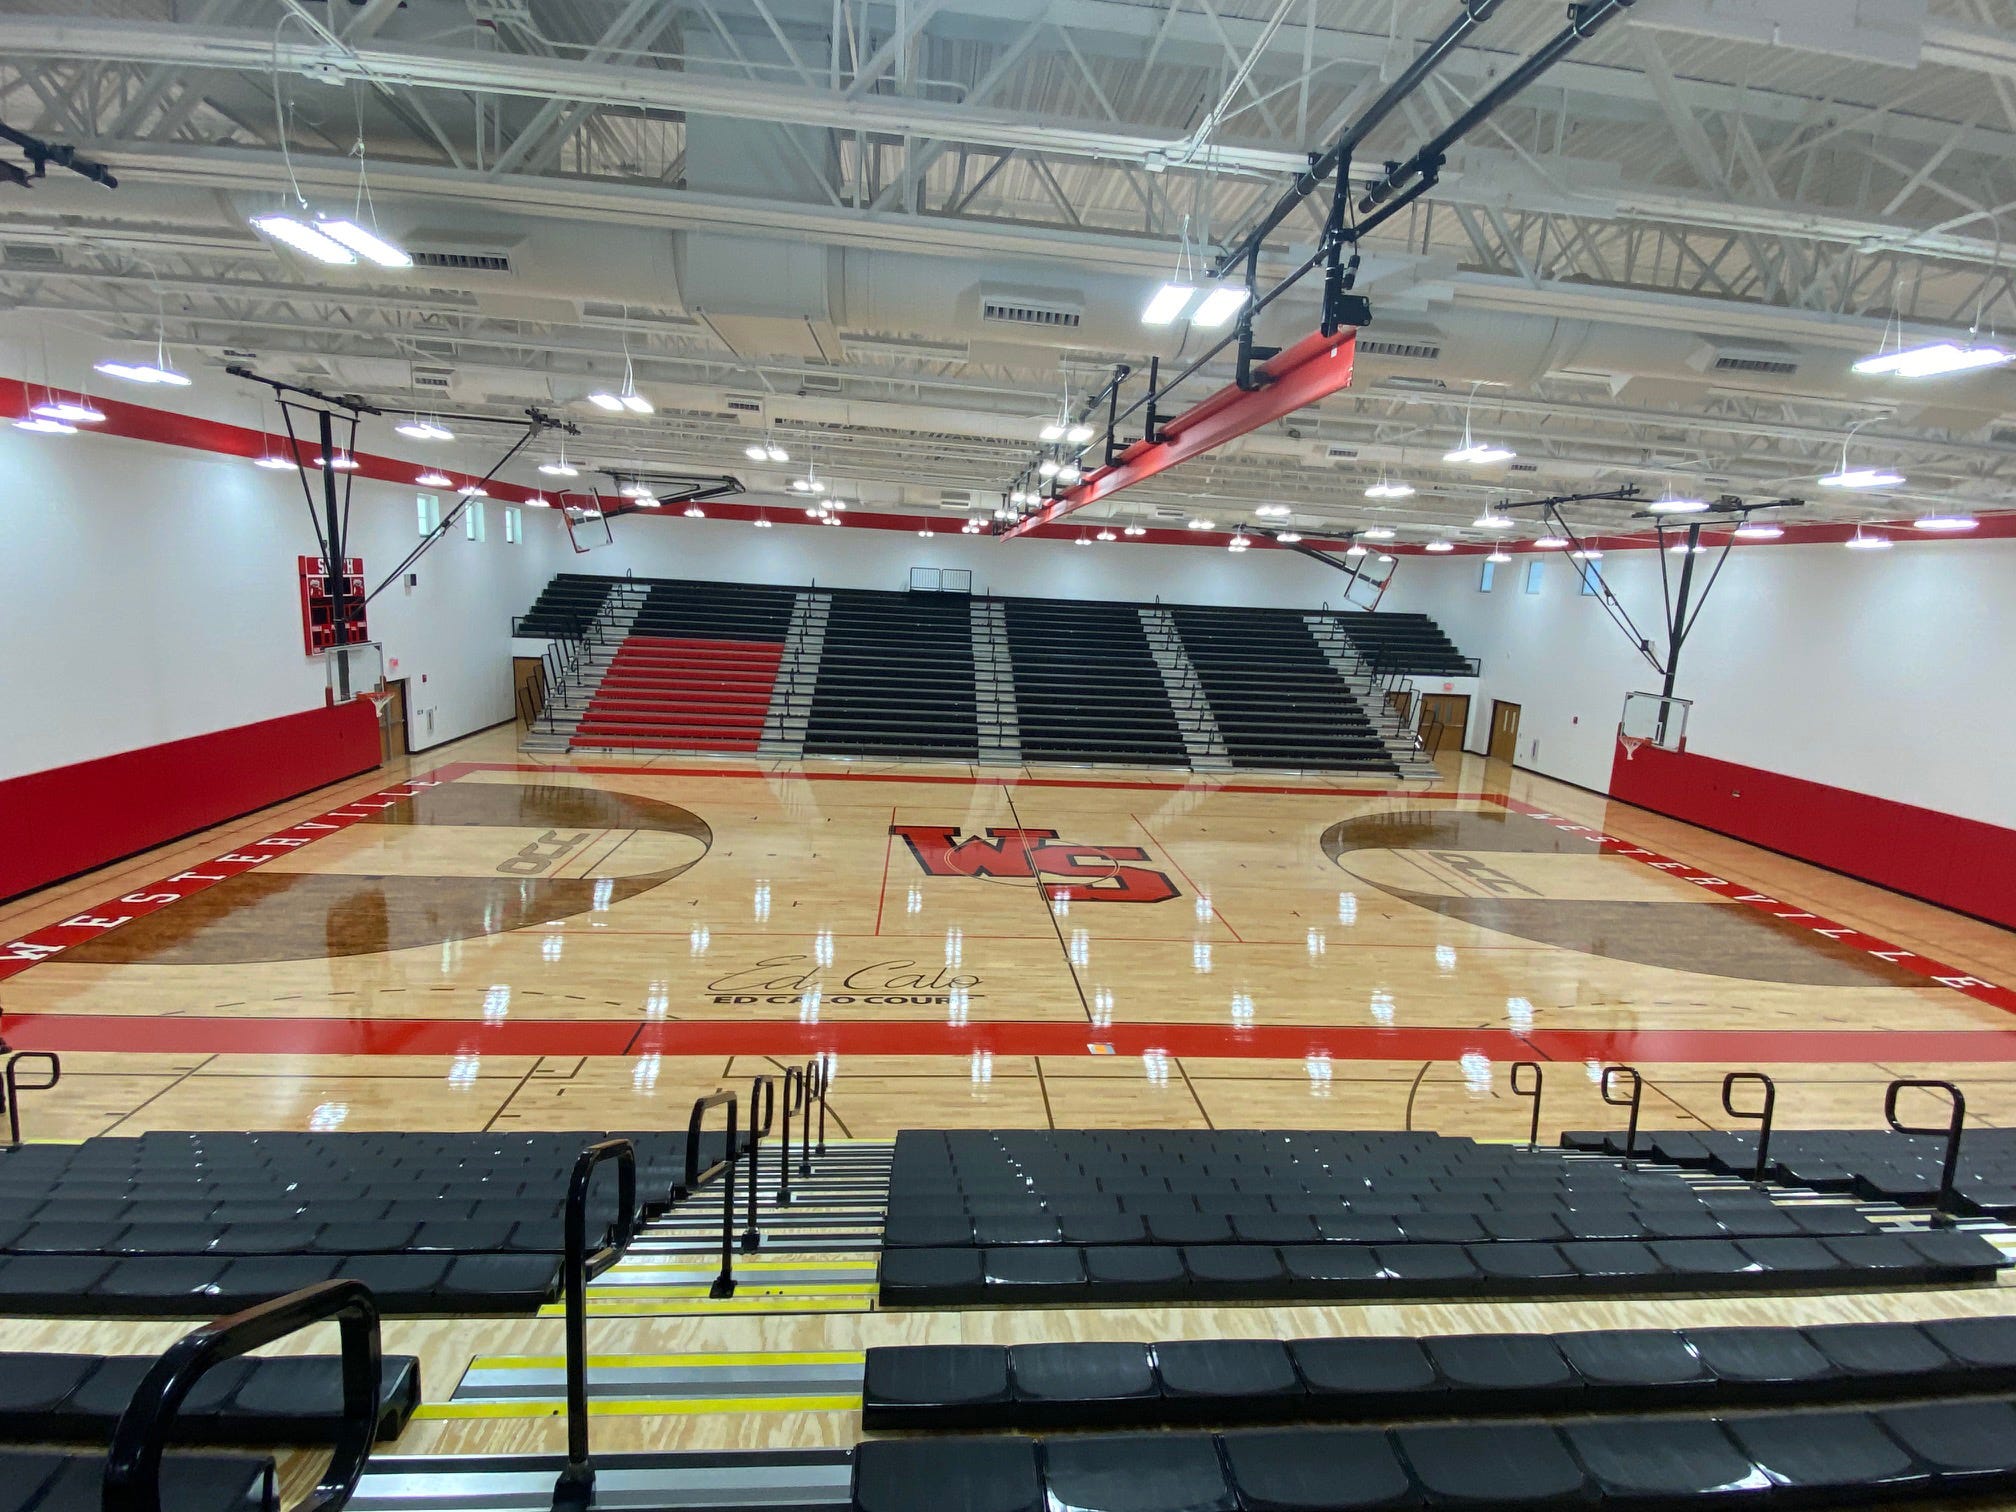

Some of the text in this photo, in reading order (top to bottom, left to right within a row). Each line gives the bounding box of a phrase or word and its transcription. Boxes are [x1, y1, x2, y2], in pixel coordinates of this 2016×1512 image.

[0, 780, 443, 960] WESTERVILLE
[1526, 813, 1997, 988] WESTERVILLE
[707, 954, 983, 991] Ed Calo
[713, 996, 759, 1004] ED
